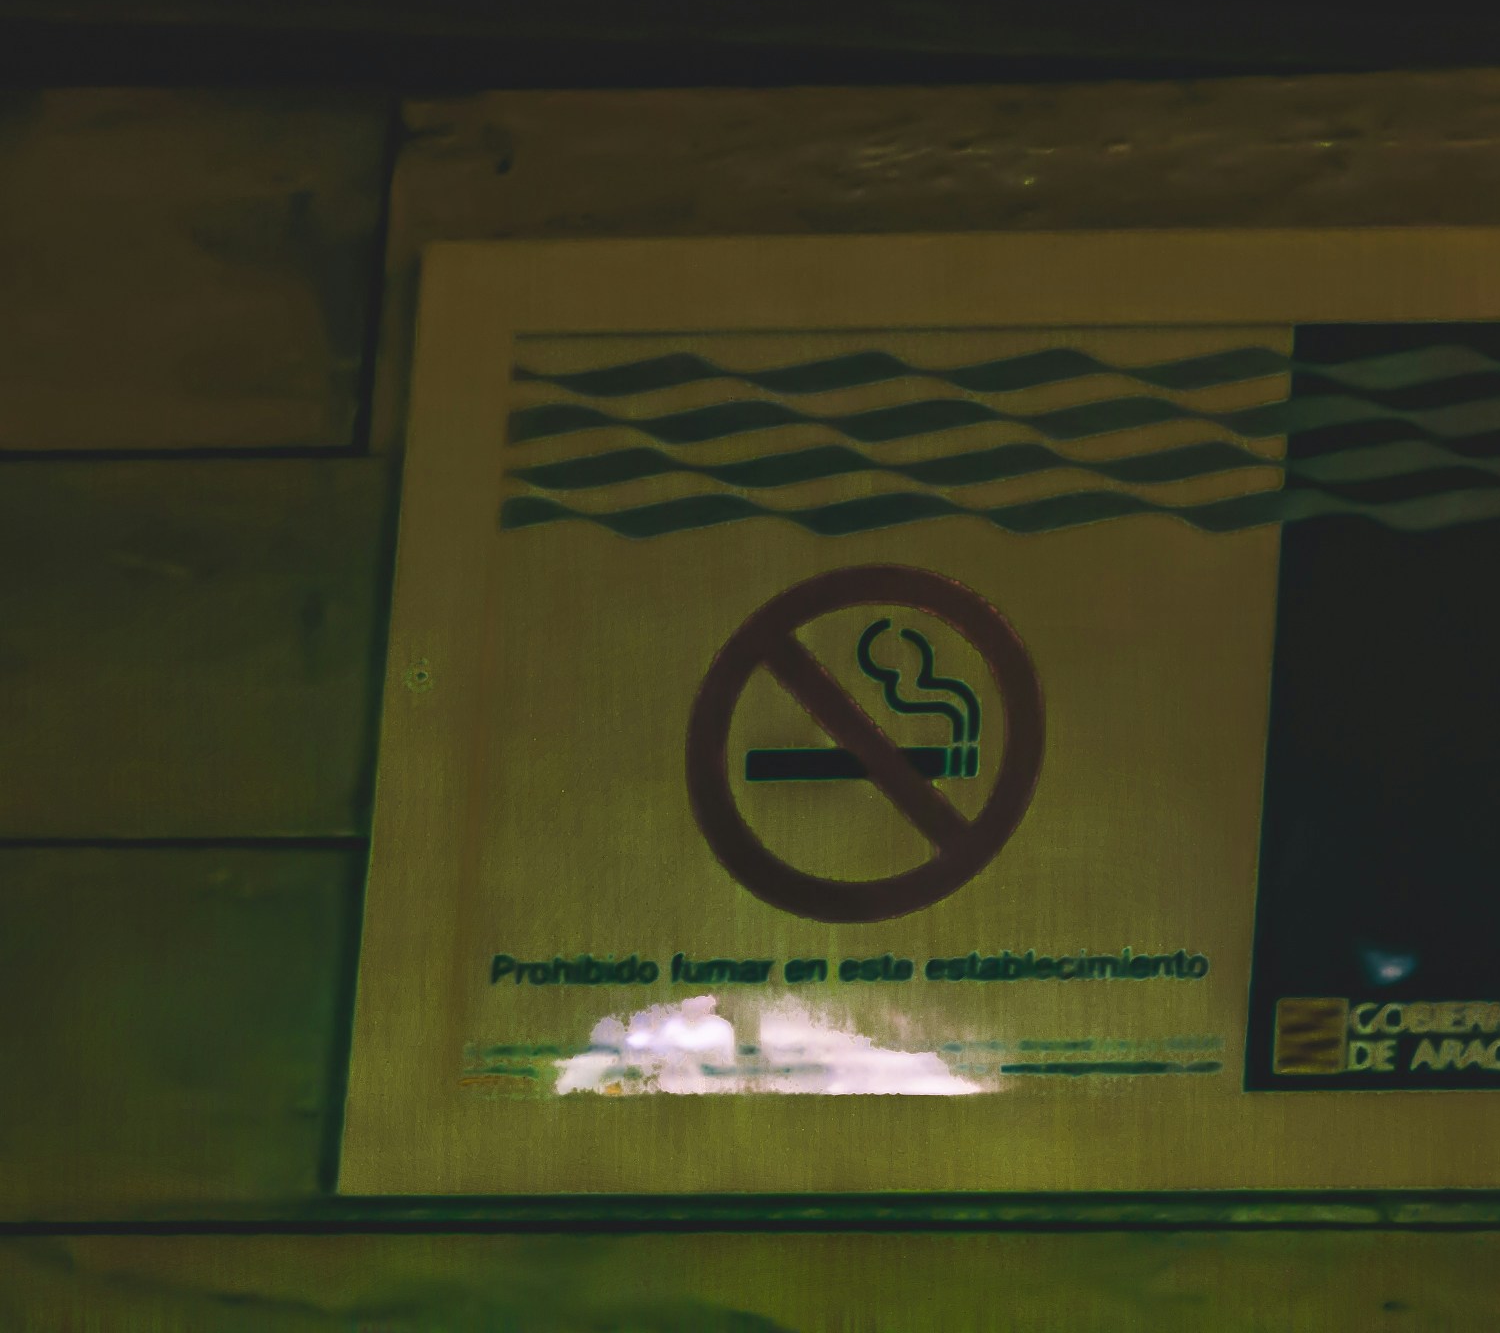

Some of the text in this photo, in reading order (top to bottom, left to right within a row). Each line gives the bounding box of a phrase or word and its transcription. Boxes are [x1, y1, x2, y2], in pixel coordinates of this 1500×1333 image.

[489, 948, 1211, 986] Prohibido fumar en este establecimiento
[1348, 1038, 1400, 1072] DE
